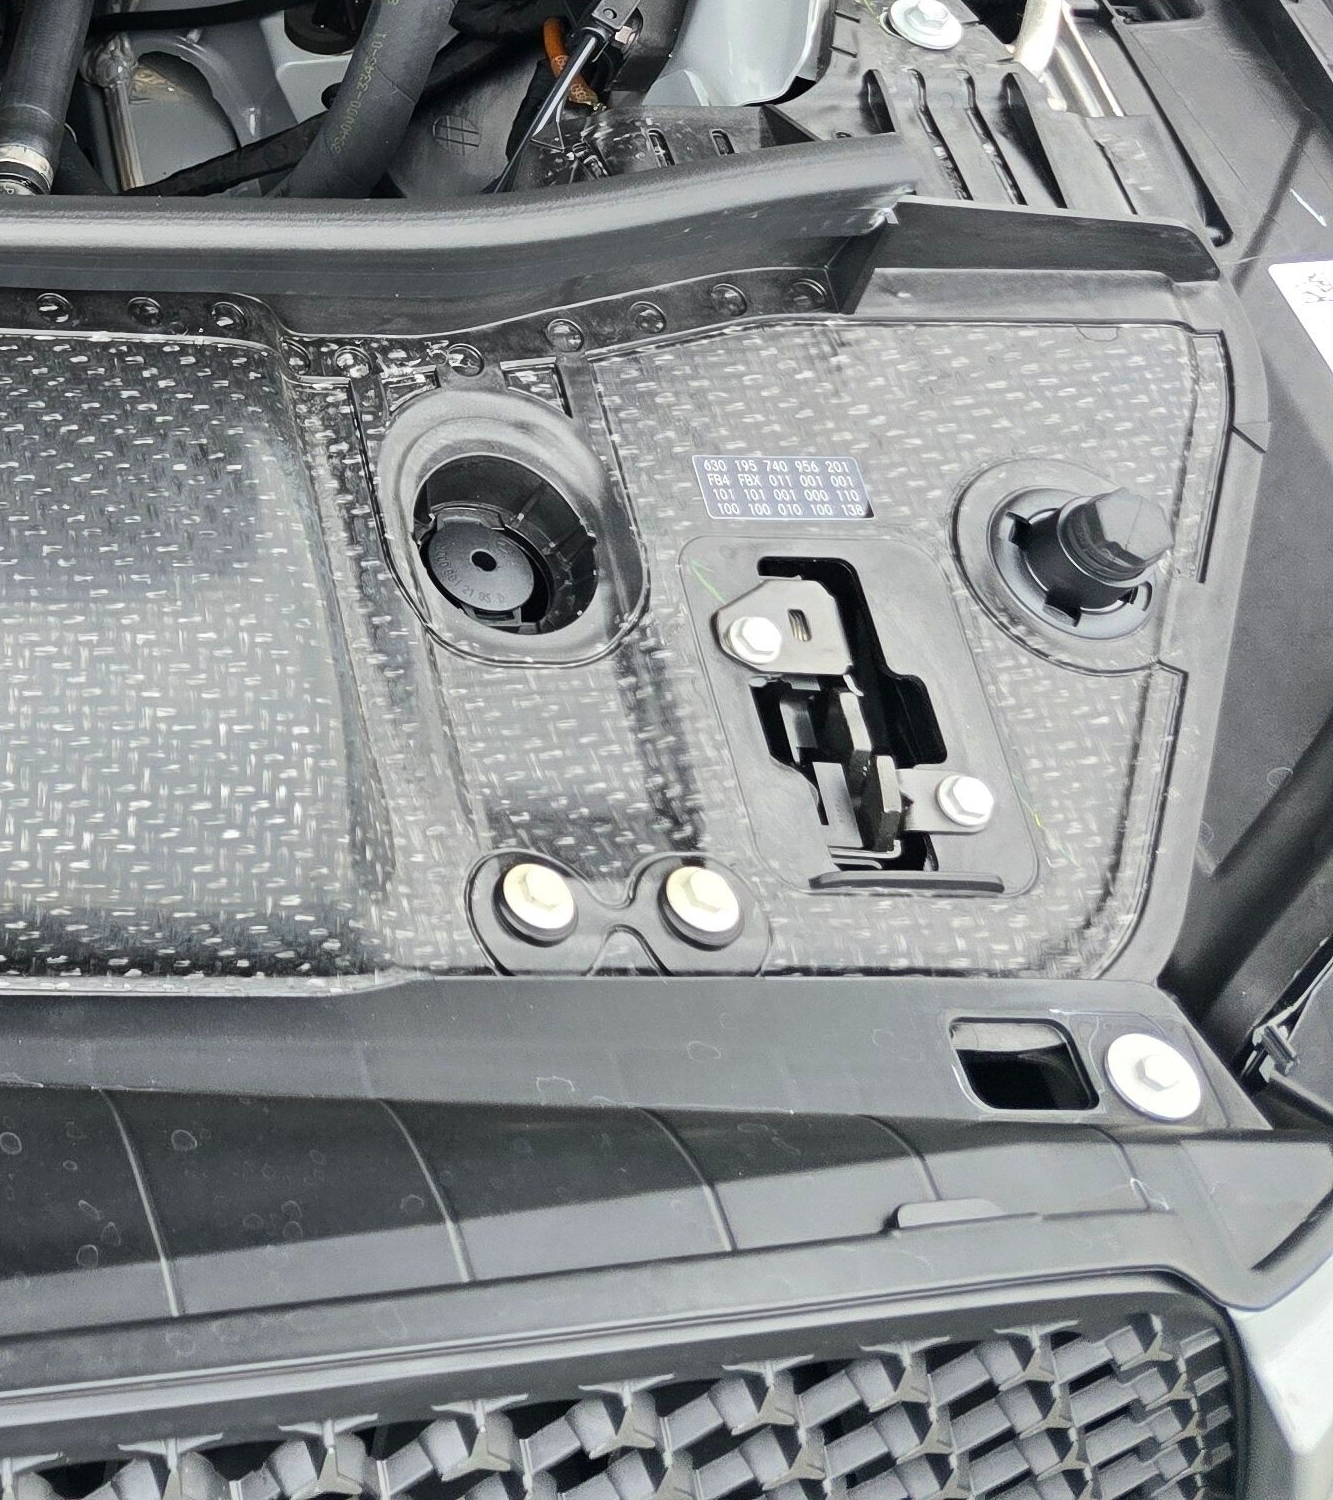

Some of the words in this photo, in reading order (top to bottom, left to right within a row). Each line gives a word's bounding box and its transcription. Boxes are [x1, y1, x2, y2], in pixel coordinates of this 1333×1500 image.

[704, 460, 726, 471] 630
[735, 460, 757, 472] 195
[763, 460, 788, 472] 740
[795, 461, 818, 472] 956
[825, 461, 848, 472] 201
[707, 474, 730, 486] FB4
[738, 474, 762, 486] FBX
[769, 475, 792, 487] 011
[800, 475, 822, 487] 001
[831, 476, 854, 487] 001
[713, 489, 733, 500] 101
[744, 490, 765, 501] 101
[774, 490, 797, 501] 001
[804, 490, 828, 501] 000
[836, 490, 859, 501] 110
[717, 504, 739, 515] 100
[748, 504, 770, 515] 100
[778, 504, 801, 515] 010
[811, 504, 832, 516] 100
[841, 505, 864, 516] 138
